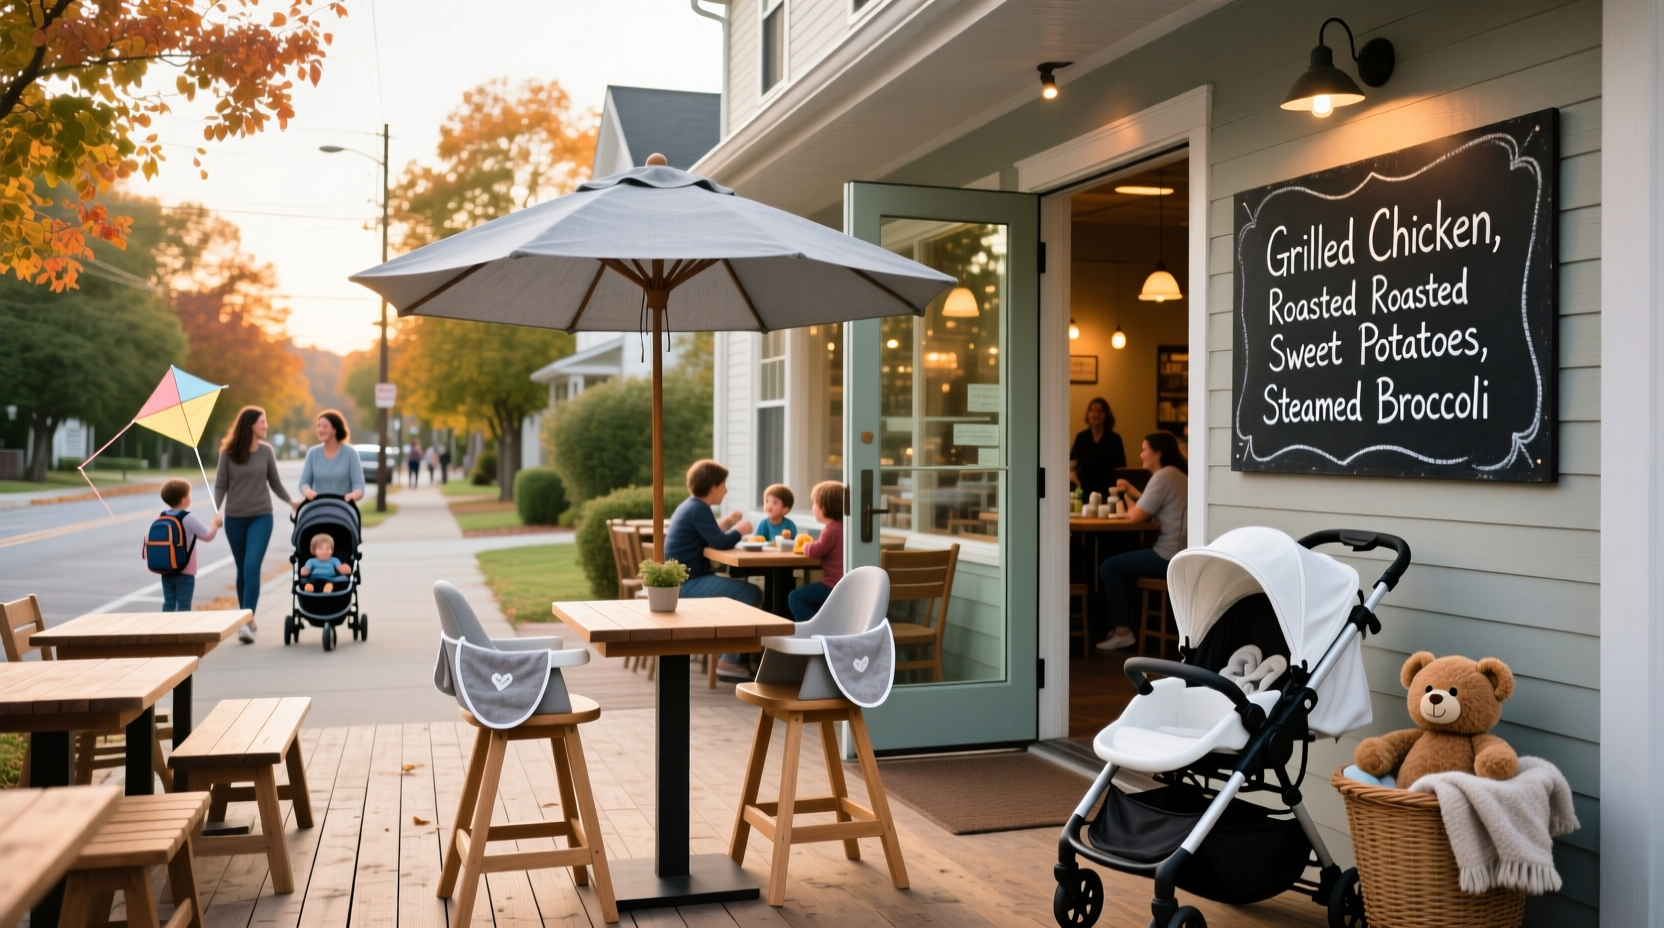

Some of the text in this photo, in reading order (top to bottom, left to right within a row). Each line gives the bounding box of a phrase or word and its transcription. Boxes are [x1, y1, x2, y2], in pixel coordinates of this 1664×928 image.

[1266, 198, 1502, 277] Grilled Chicken,
[1268, 266, 1469, 326] Roasted Roasted
[1268, 321, 1488, 372] Sweet Potatoes,
[1262, 375, 1489, 425] Steamed Broccoli
